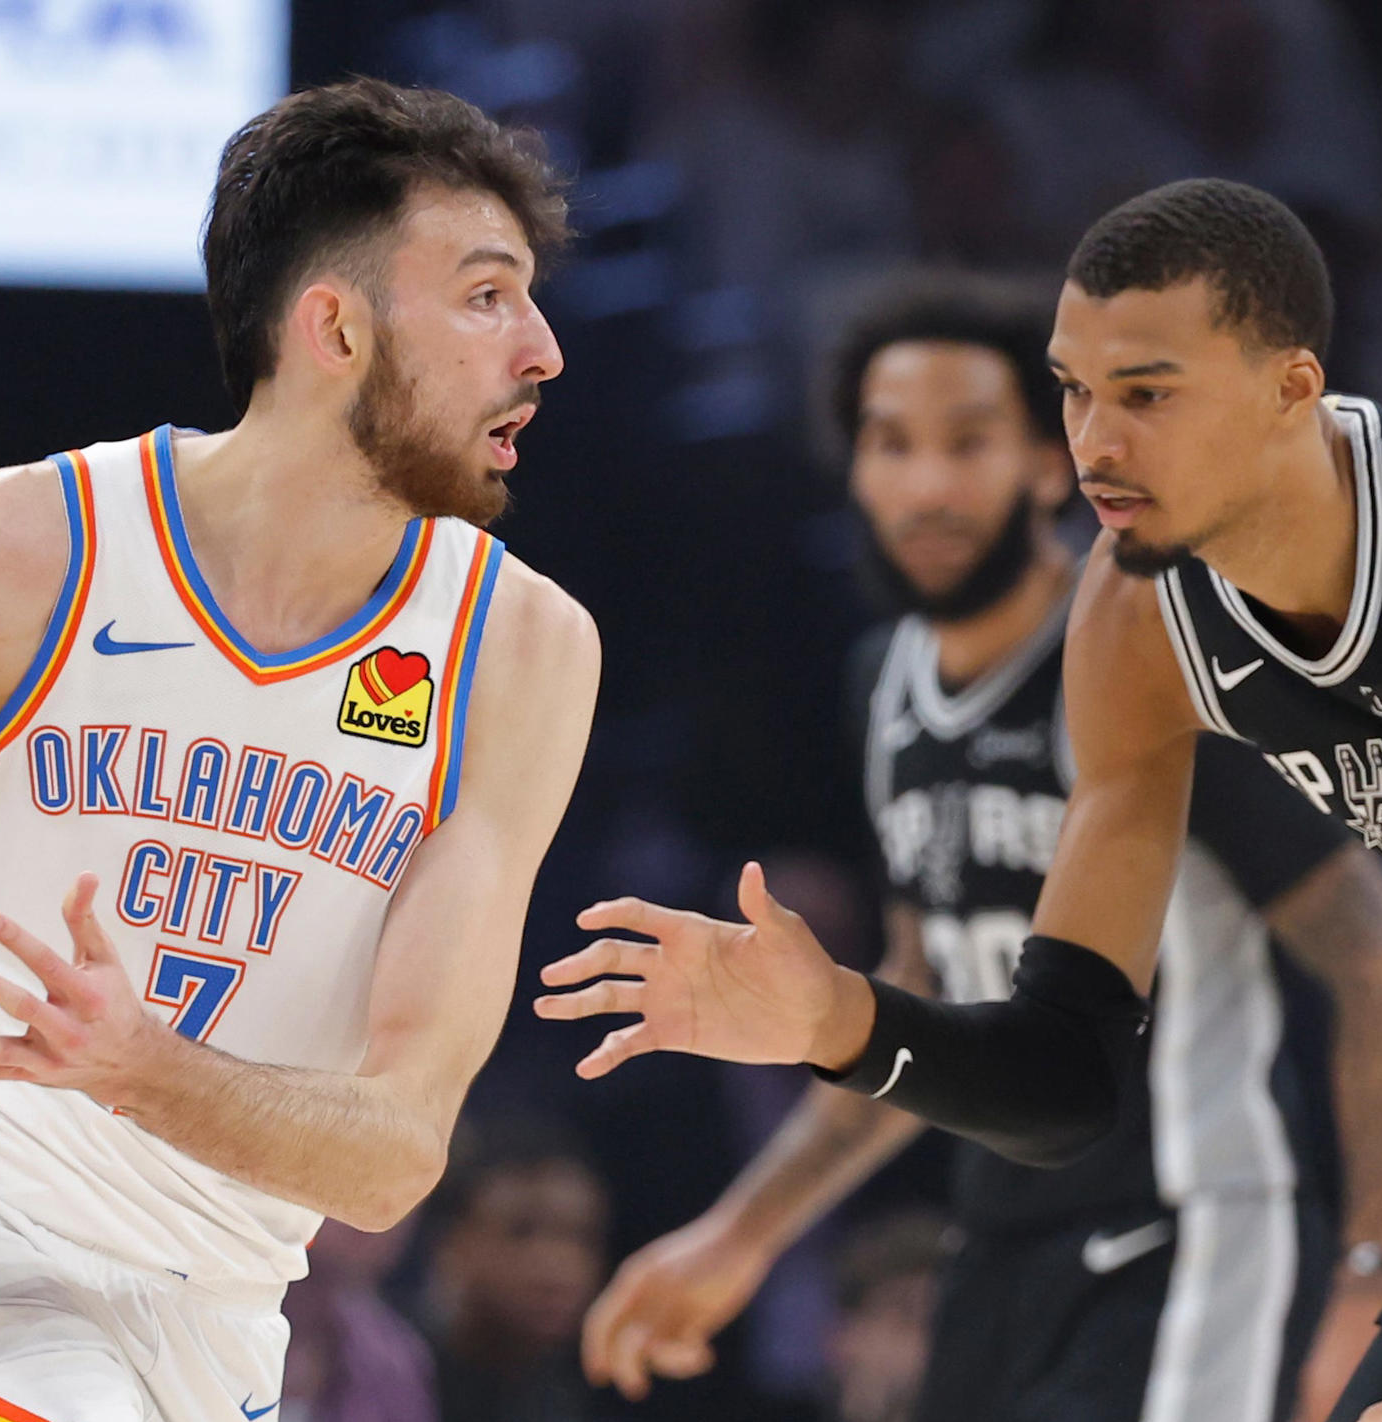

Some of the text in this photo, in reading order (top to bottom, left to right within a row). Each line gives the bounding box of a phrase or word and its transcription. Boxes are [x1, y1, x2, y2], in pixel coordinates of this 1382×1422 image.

[26, 724, 426, 891] OKLAHOMA
[117, 839, 303, 955] CITY
[144, 943, 246, 1046] 7
